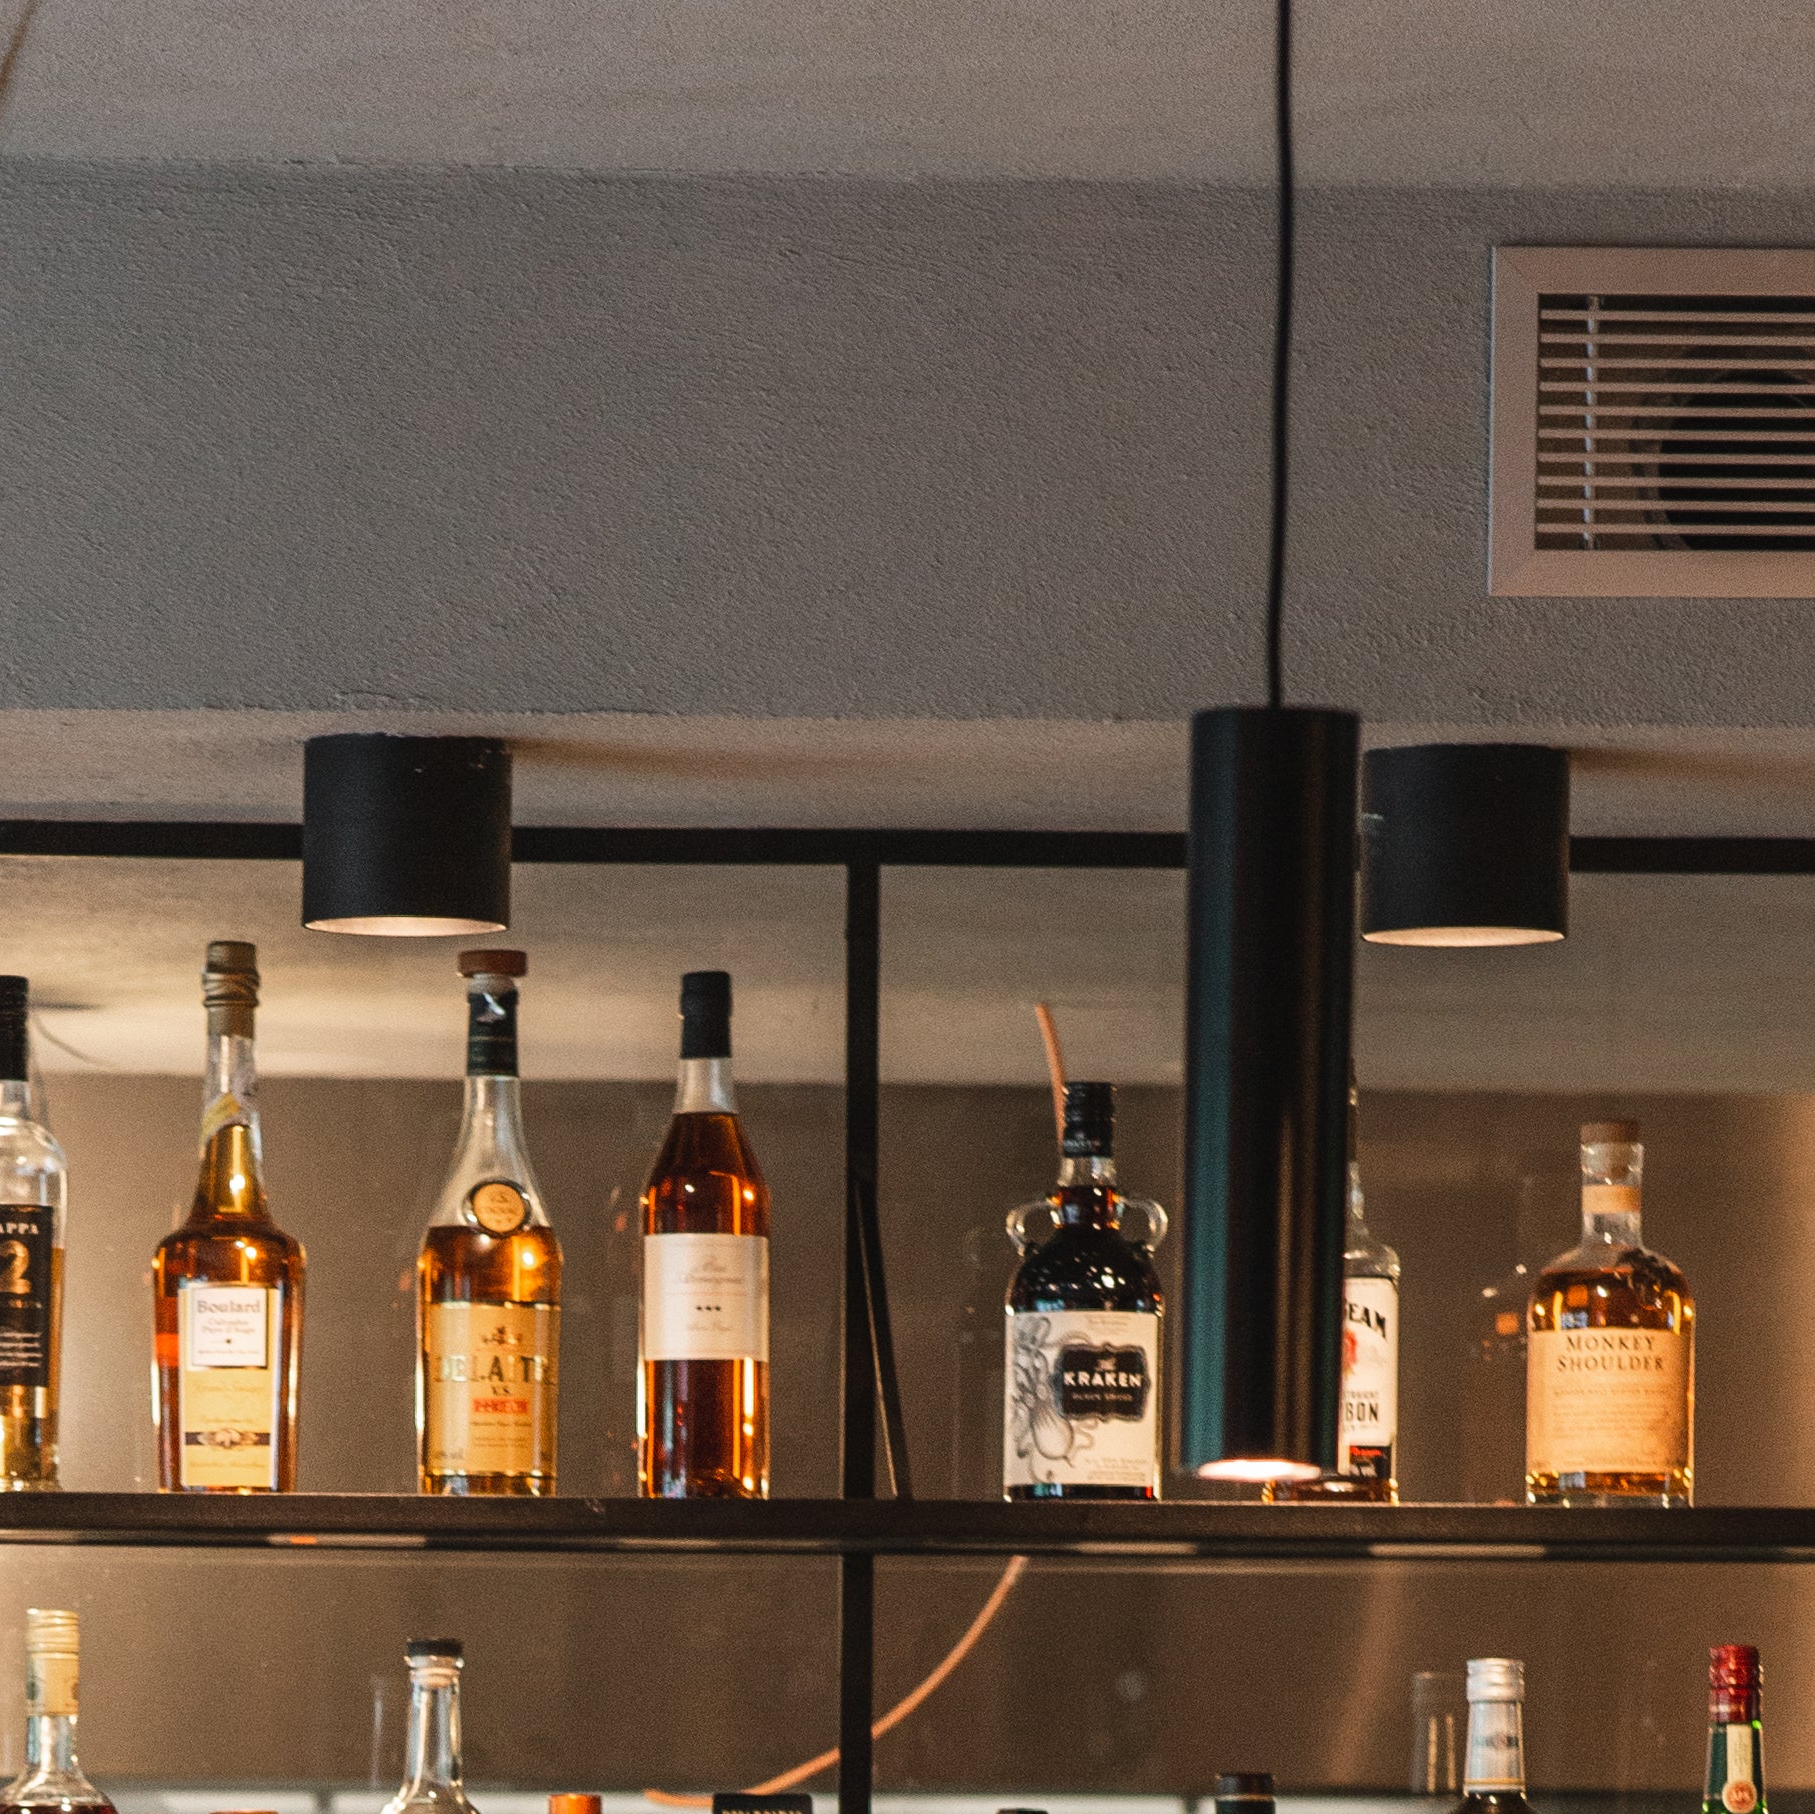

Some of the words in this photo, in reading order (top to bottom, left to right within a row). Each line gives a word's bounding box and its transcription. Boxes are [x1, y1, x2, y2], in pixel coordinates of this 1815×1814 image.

[197, 1300, 261, 1314] Boulard
[1349, 1303, 1387, 1338] EAM
[1566, 1335, 1655, 1350] MONKEY
[1557, 1355, 1664, 1372] SHOULDER
[1063, 1371, 1143, 1387] KRAKEN
